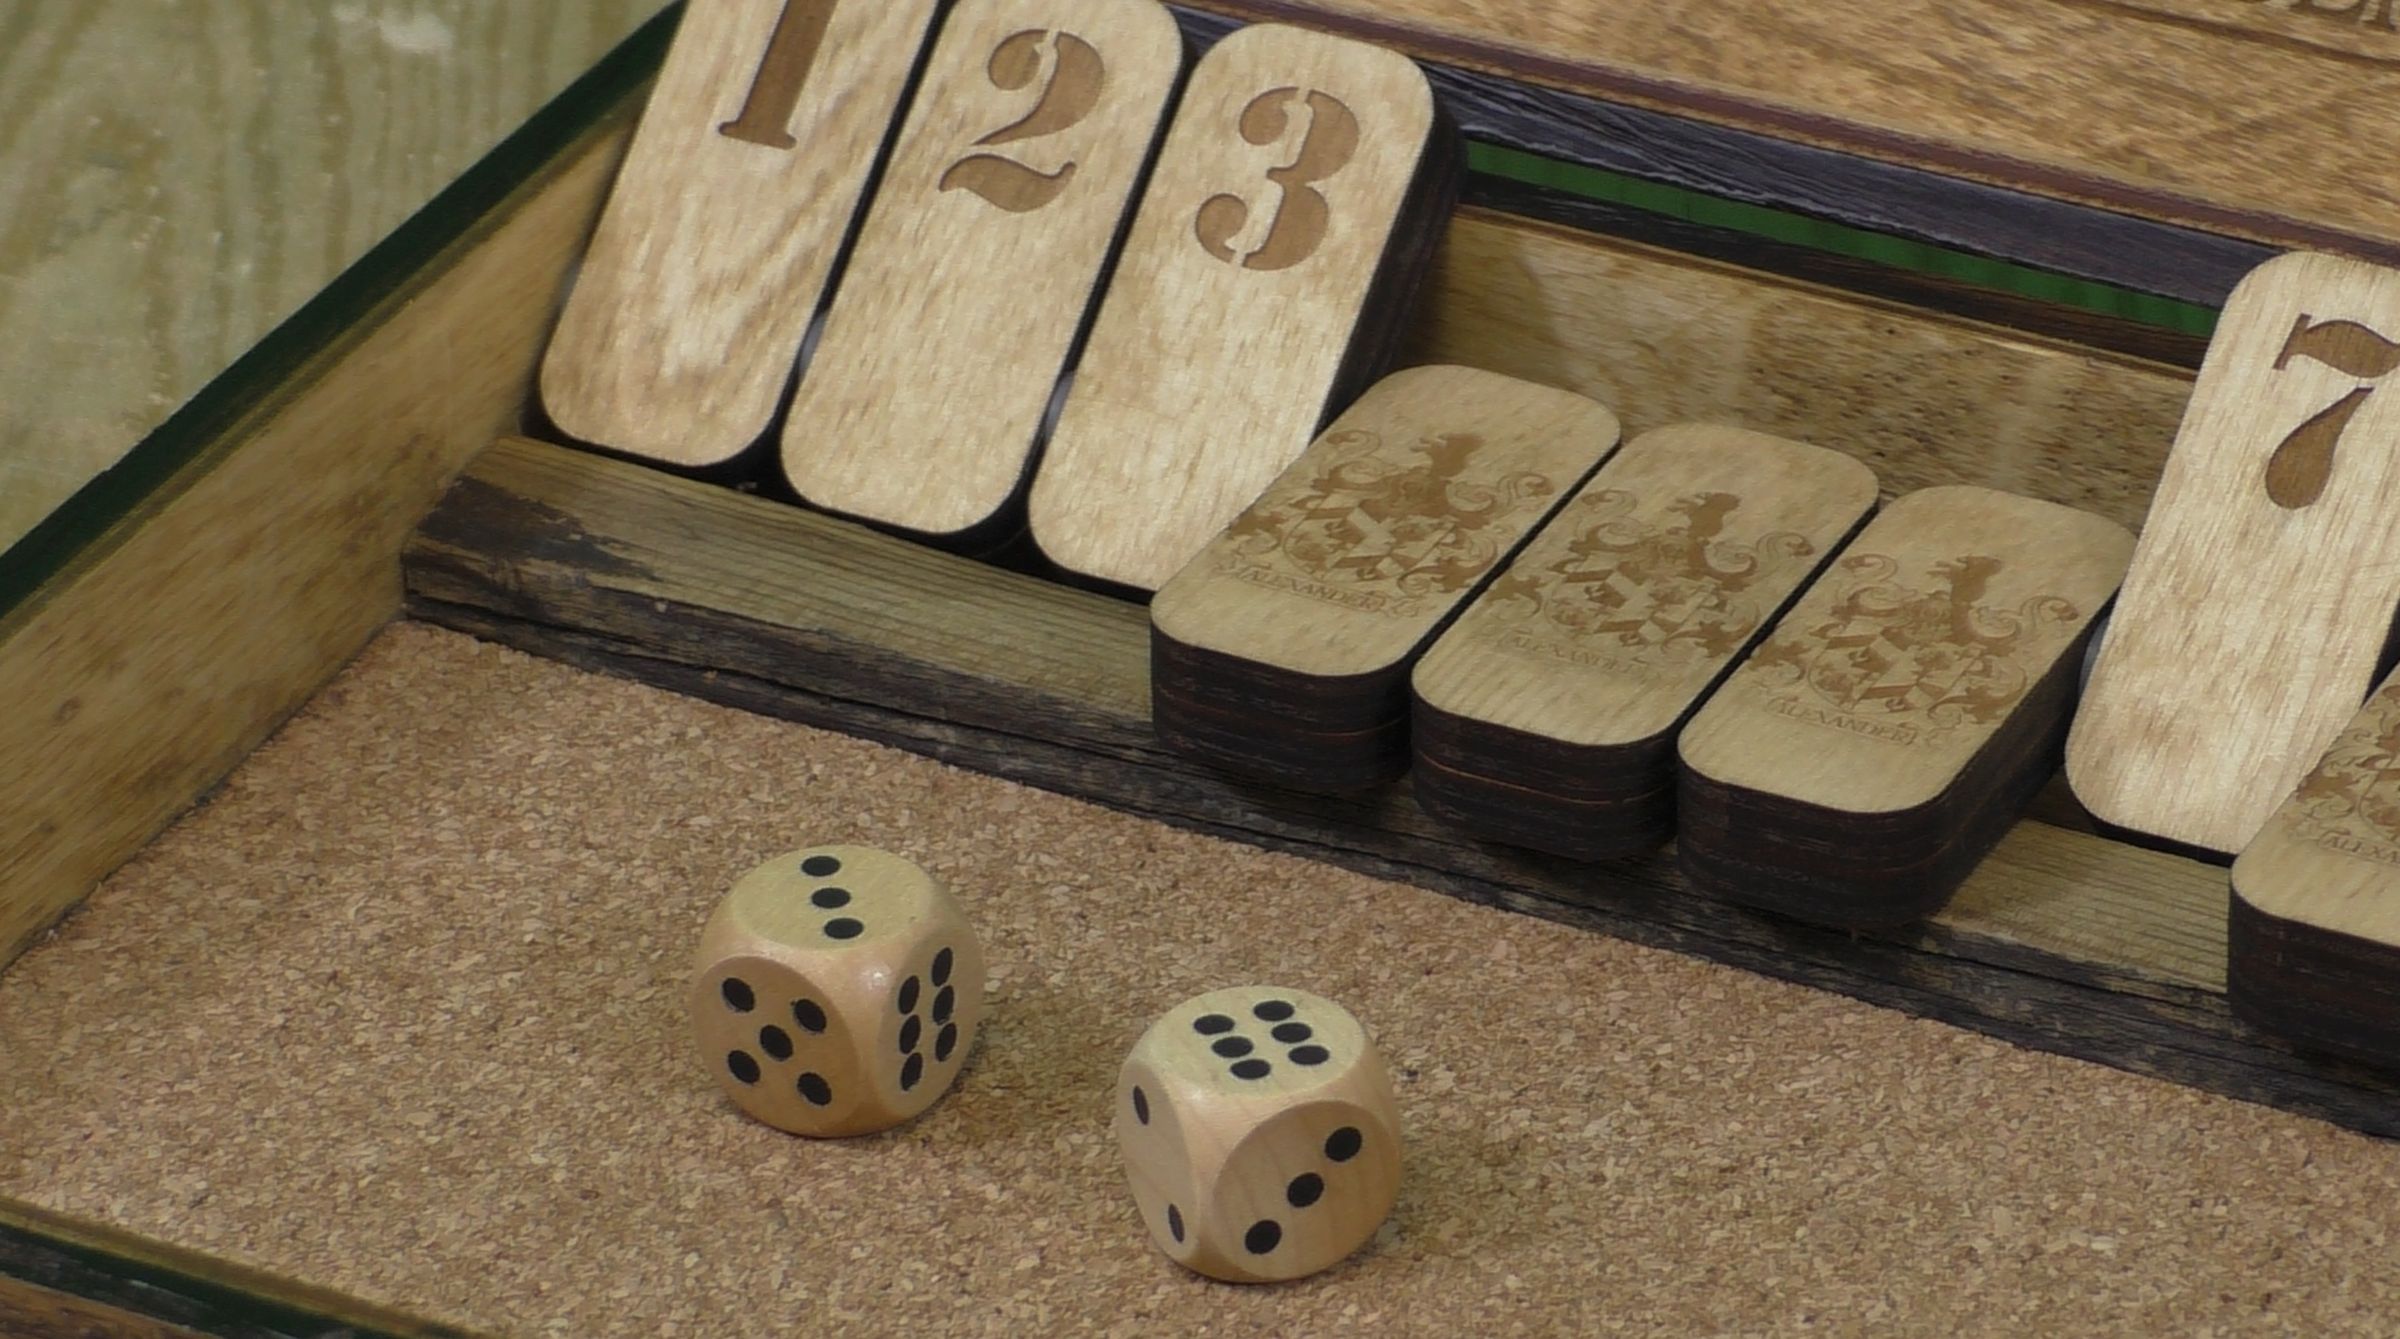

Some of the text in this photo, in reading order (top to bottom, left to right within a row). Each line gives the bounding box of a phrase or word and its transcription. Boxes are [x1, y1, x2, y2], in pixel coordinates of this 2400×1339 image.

[718, 0, 833, 150] 1
[938, 28, 1104, 213] 2
[1195, 86, 1360, 271] 3
[2265, 313, 2400, 510] 7
[1243, 569, 1375, 610] ALEXANDER
[1776, 701, 1911, 743] ALEXANDER
